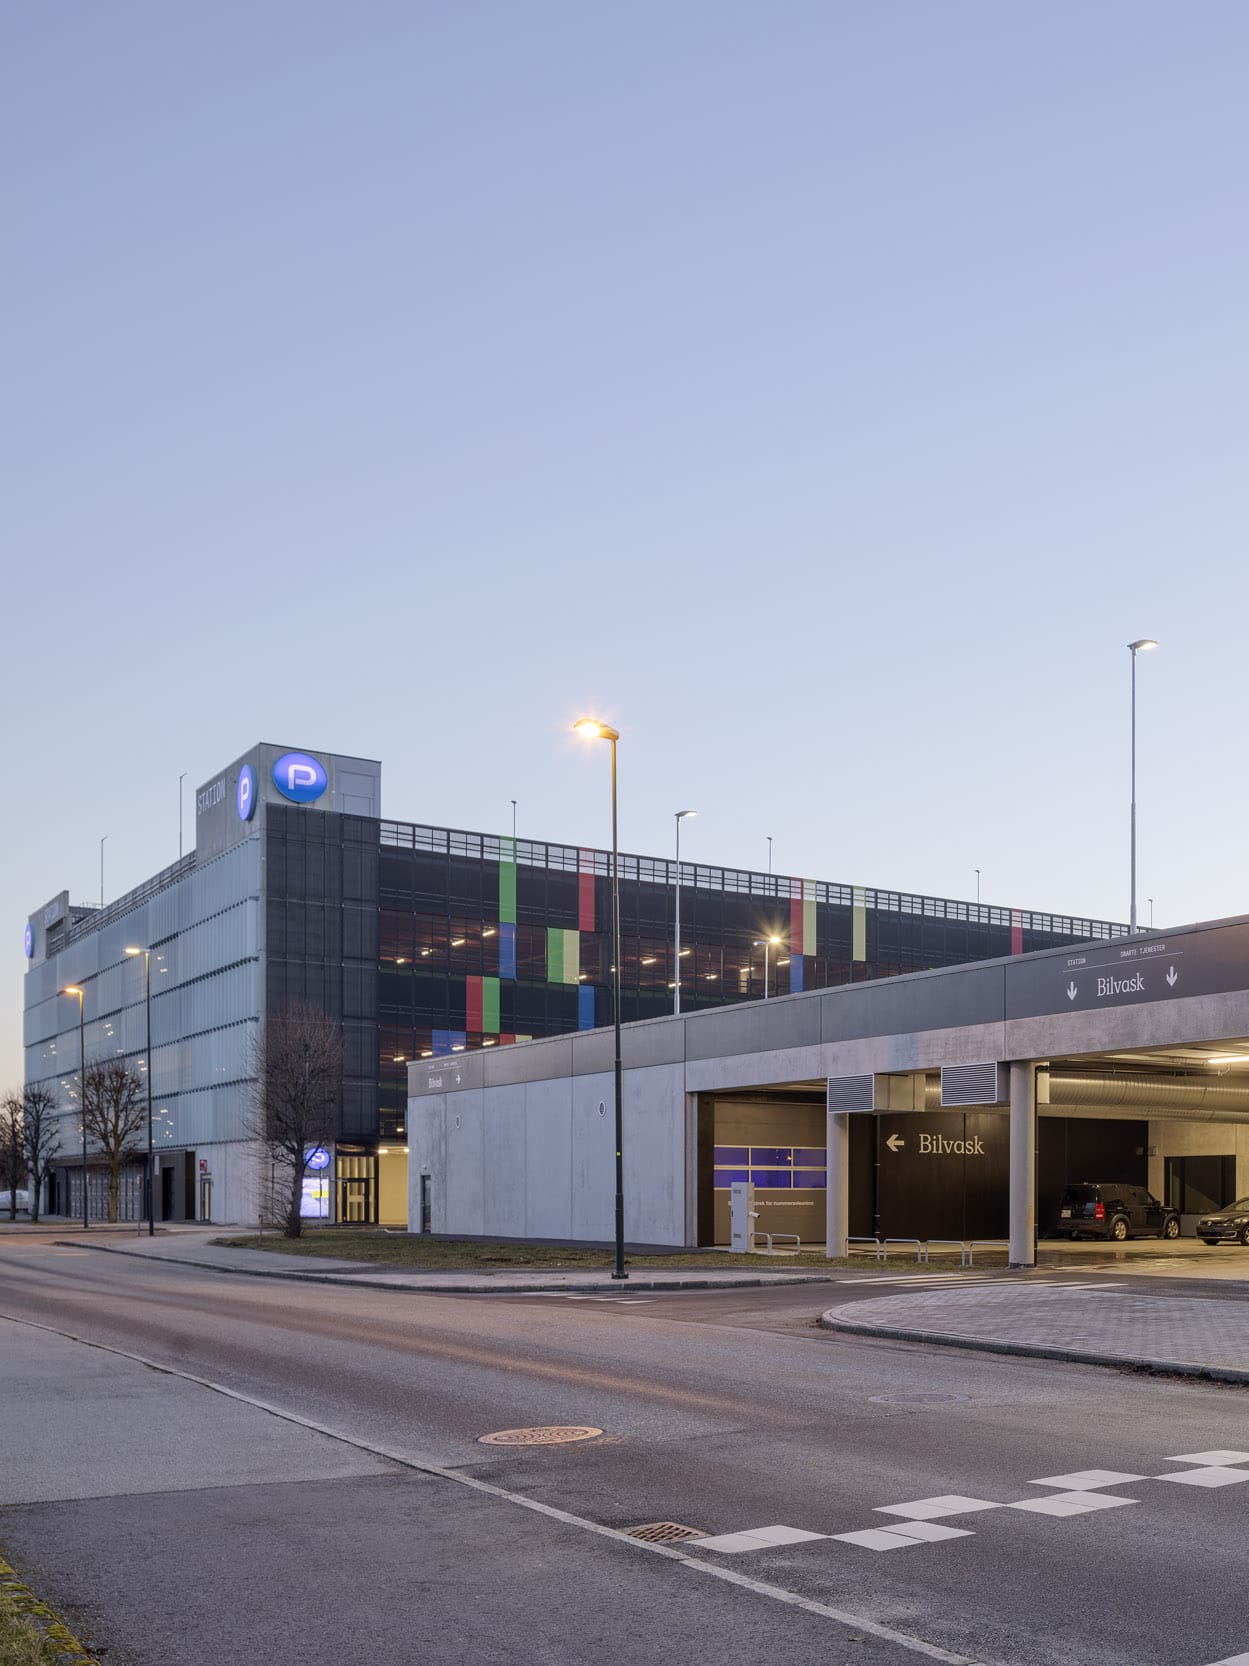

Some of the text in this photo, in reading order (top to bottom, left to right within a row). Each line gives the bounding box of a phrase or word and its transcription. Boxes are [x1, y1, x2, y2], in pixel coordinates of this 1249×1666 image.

[288, 764, 317, 790] P
[198, 778, 226, 816] STATION
[240, 777, 249, 809] P
[1096, 972, 1145, 997] Bilvask
[918, 1133, 985, 1155] Bilvask
